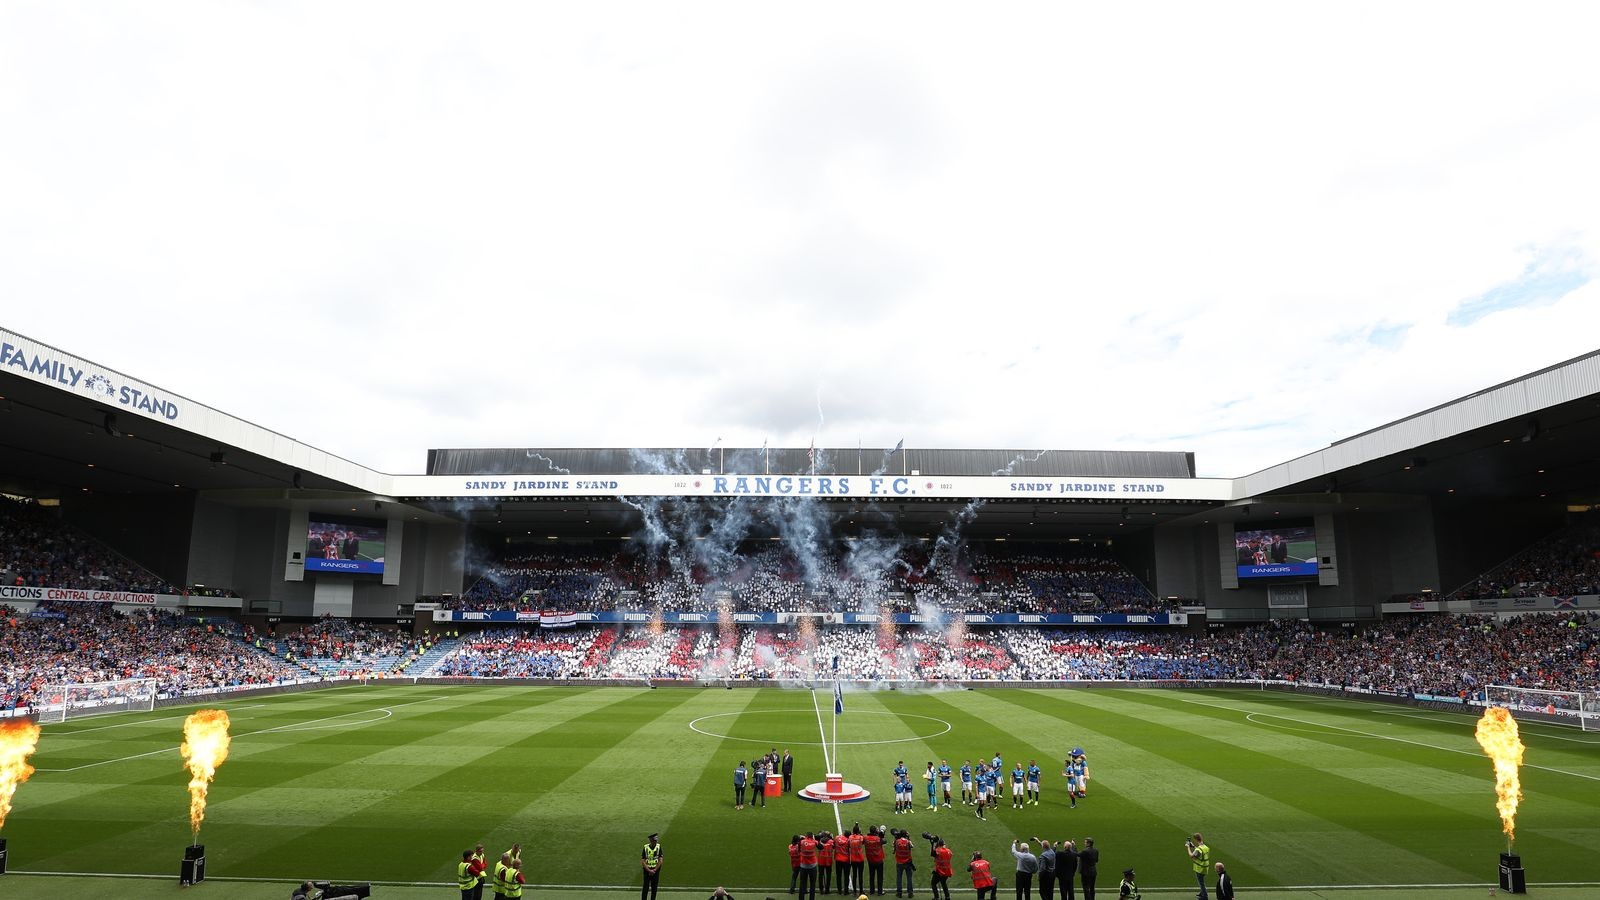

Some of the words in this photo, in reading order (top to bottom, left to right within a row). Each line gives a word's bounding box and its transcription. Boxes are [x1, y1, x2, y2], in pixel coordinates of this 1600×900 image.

[0, 342, 83, 387] FAMILY
[118, 385, 178, 420] STAND
[465, 481, 507, 489] SANDY
[513, 481, 569, 491] JARDINE
[576, 481, 618, 489] STAND
[713, 477, 850, 494] RANGERS
[869, 478, 917, 495] F.C.
[1010, 482, 1053, 492] SANDY
[1060, 483, 1116, 493] JARDINE
[1122, 484, 1165, 493] STAND
[320, 561, 359, 569] RANGERS
[47, 589, 91, 600] CENTRAL
[93, 591, 111, 601] CAR
[112, 593, 155, 603] AUCTIONS
[463, 612, 484, 620] PUMA
[624, 613, 646, 621] PUMA
[679, 613, 701, 621] PUMA
[733, 613, 755, 621] PUMA
[855, 614, 877, 622] PUMA
[965, 614, 986, 622] PUMA
[1018, 614, 1040, 622] PUMA
[1073, 614, 1095, 622] PUMA
[1126, 615, 1148, 623] PUMA
[1417, 701, 1467, 713] CHAMPIONS
